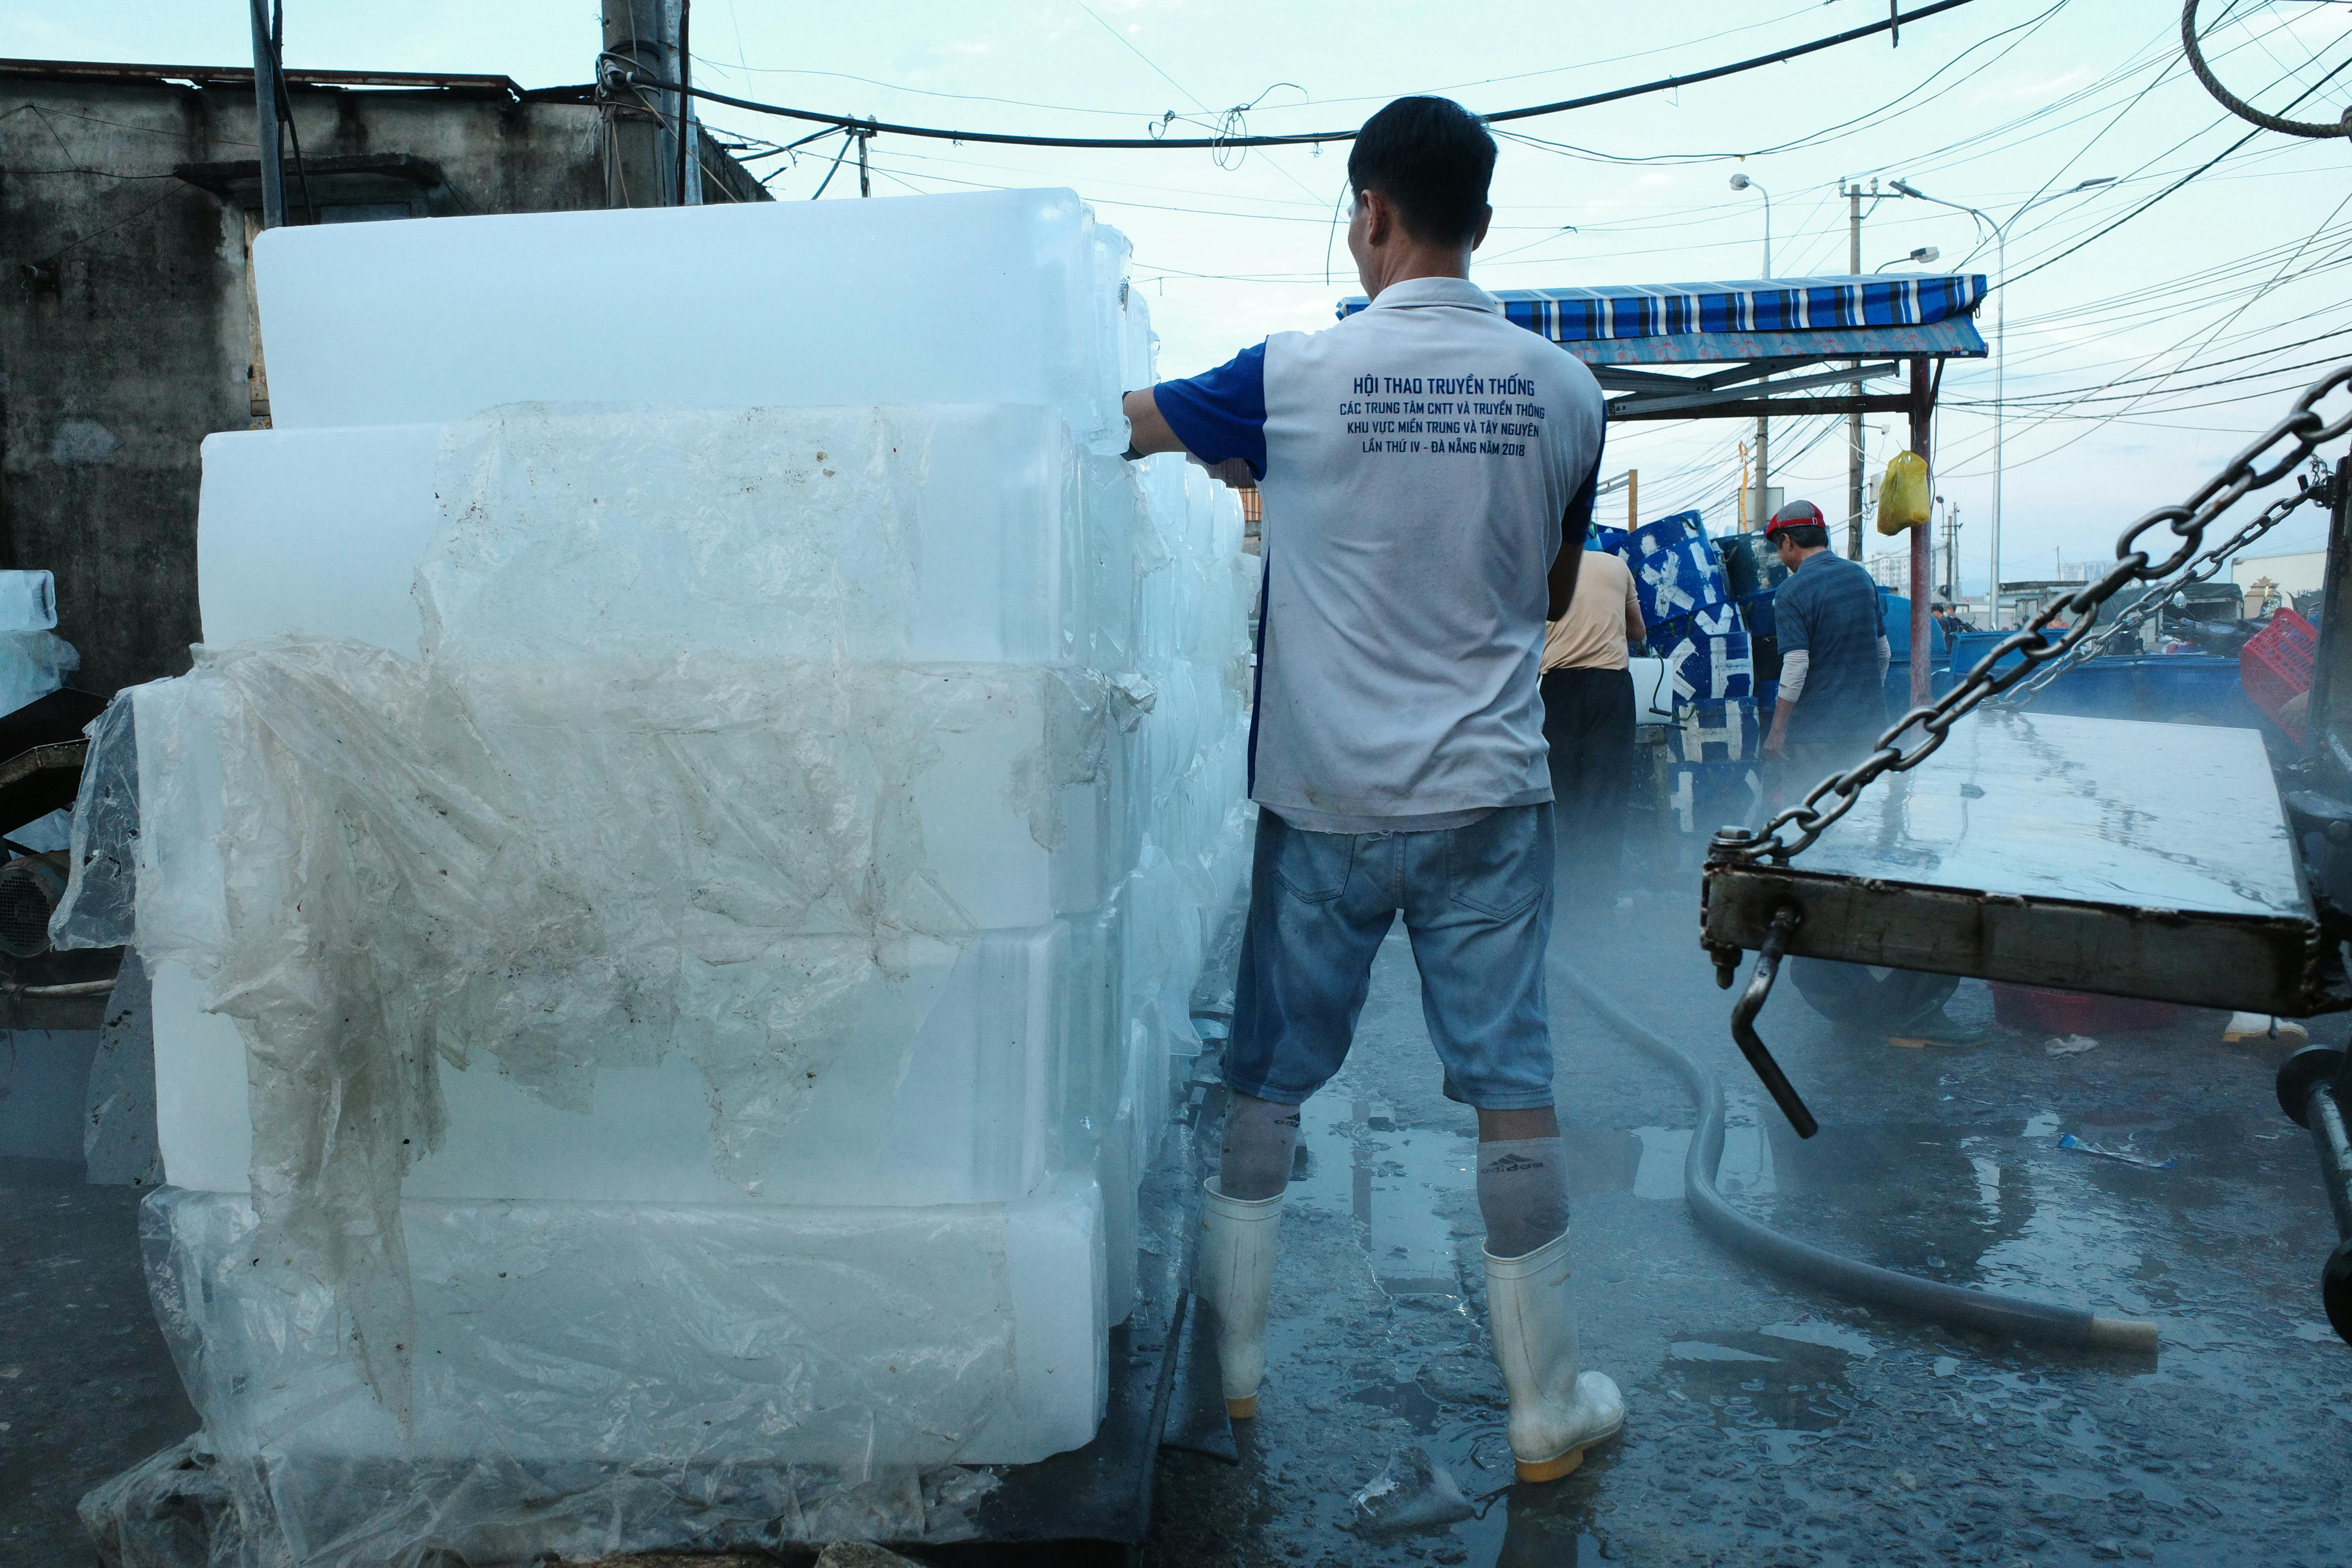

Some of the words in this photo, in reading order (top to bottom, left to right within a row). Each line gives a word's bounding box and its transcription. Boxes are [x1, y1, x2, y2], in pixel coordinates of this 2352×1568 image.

[1354, 374, 1378, 396] HỘI
[1384, 377, 1422, 394] THAO
[1427, 374, 1484, 394] TRUYỀN
[1489, 373, 1534, 396] THỐNG
[1340, 401, 1361, 416] CÁC
[1365, 402, 1400, 414] TRUNG
[1403, 400, 1424, 414] TÂM
[1427, 402, 1454, 414] CNTT
[1457, 401, 1470, 414] VÀ
[1473, 400, 1512, 416] TRUYỀN
[1515, 403, 1545, 419] THÔNG
[1348, 421, 1368, 434] KHU
[1372, 421, 1394, 435] VỰC
[1426, 421, 1460, 434] TRUNG
[1463, 419, 1477, 434] VÀ
[1480, 420, 1498, 434] TÂY
[1501, 422, 1539, 438] NGUYÊN
[1363, 437, 1382, 453] LẦN
[1385, 439, 1407, 453] THỨ
[1410, 441, 1420, 453] IV
[1431, 439, 1445, 453] ĐÀ
[1479, 440, 1500, 455] NĂM
[1502, 443, 1525, 457] 2018
